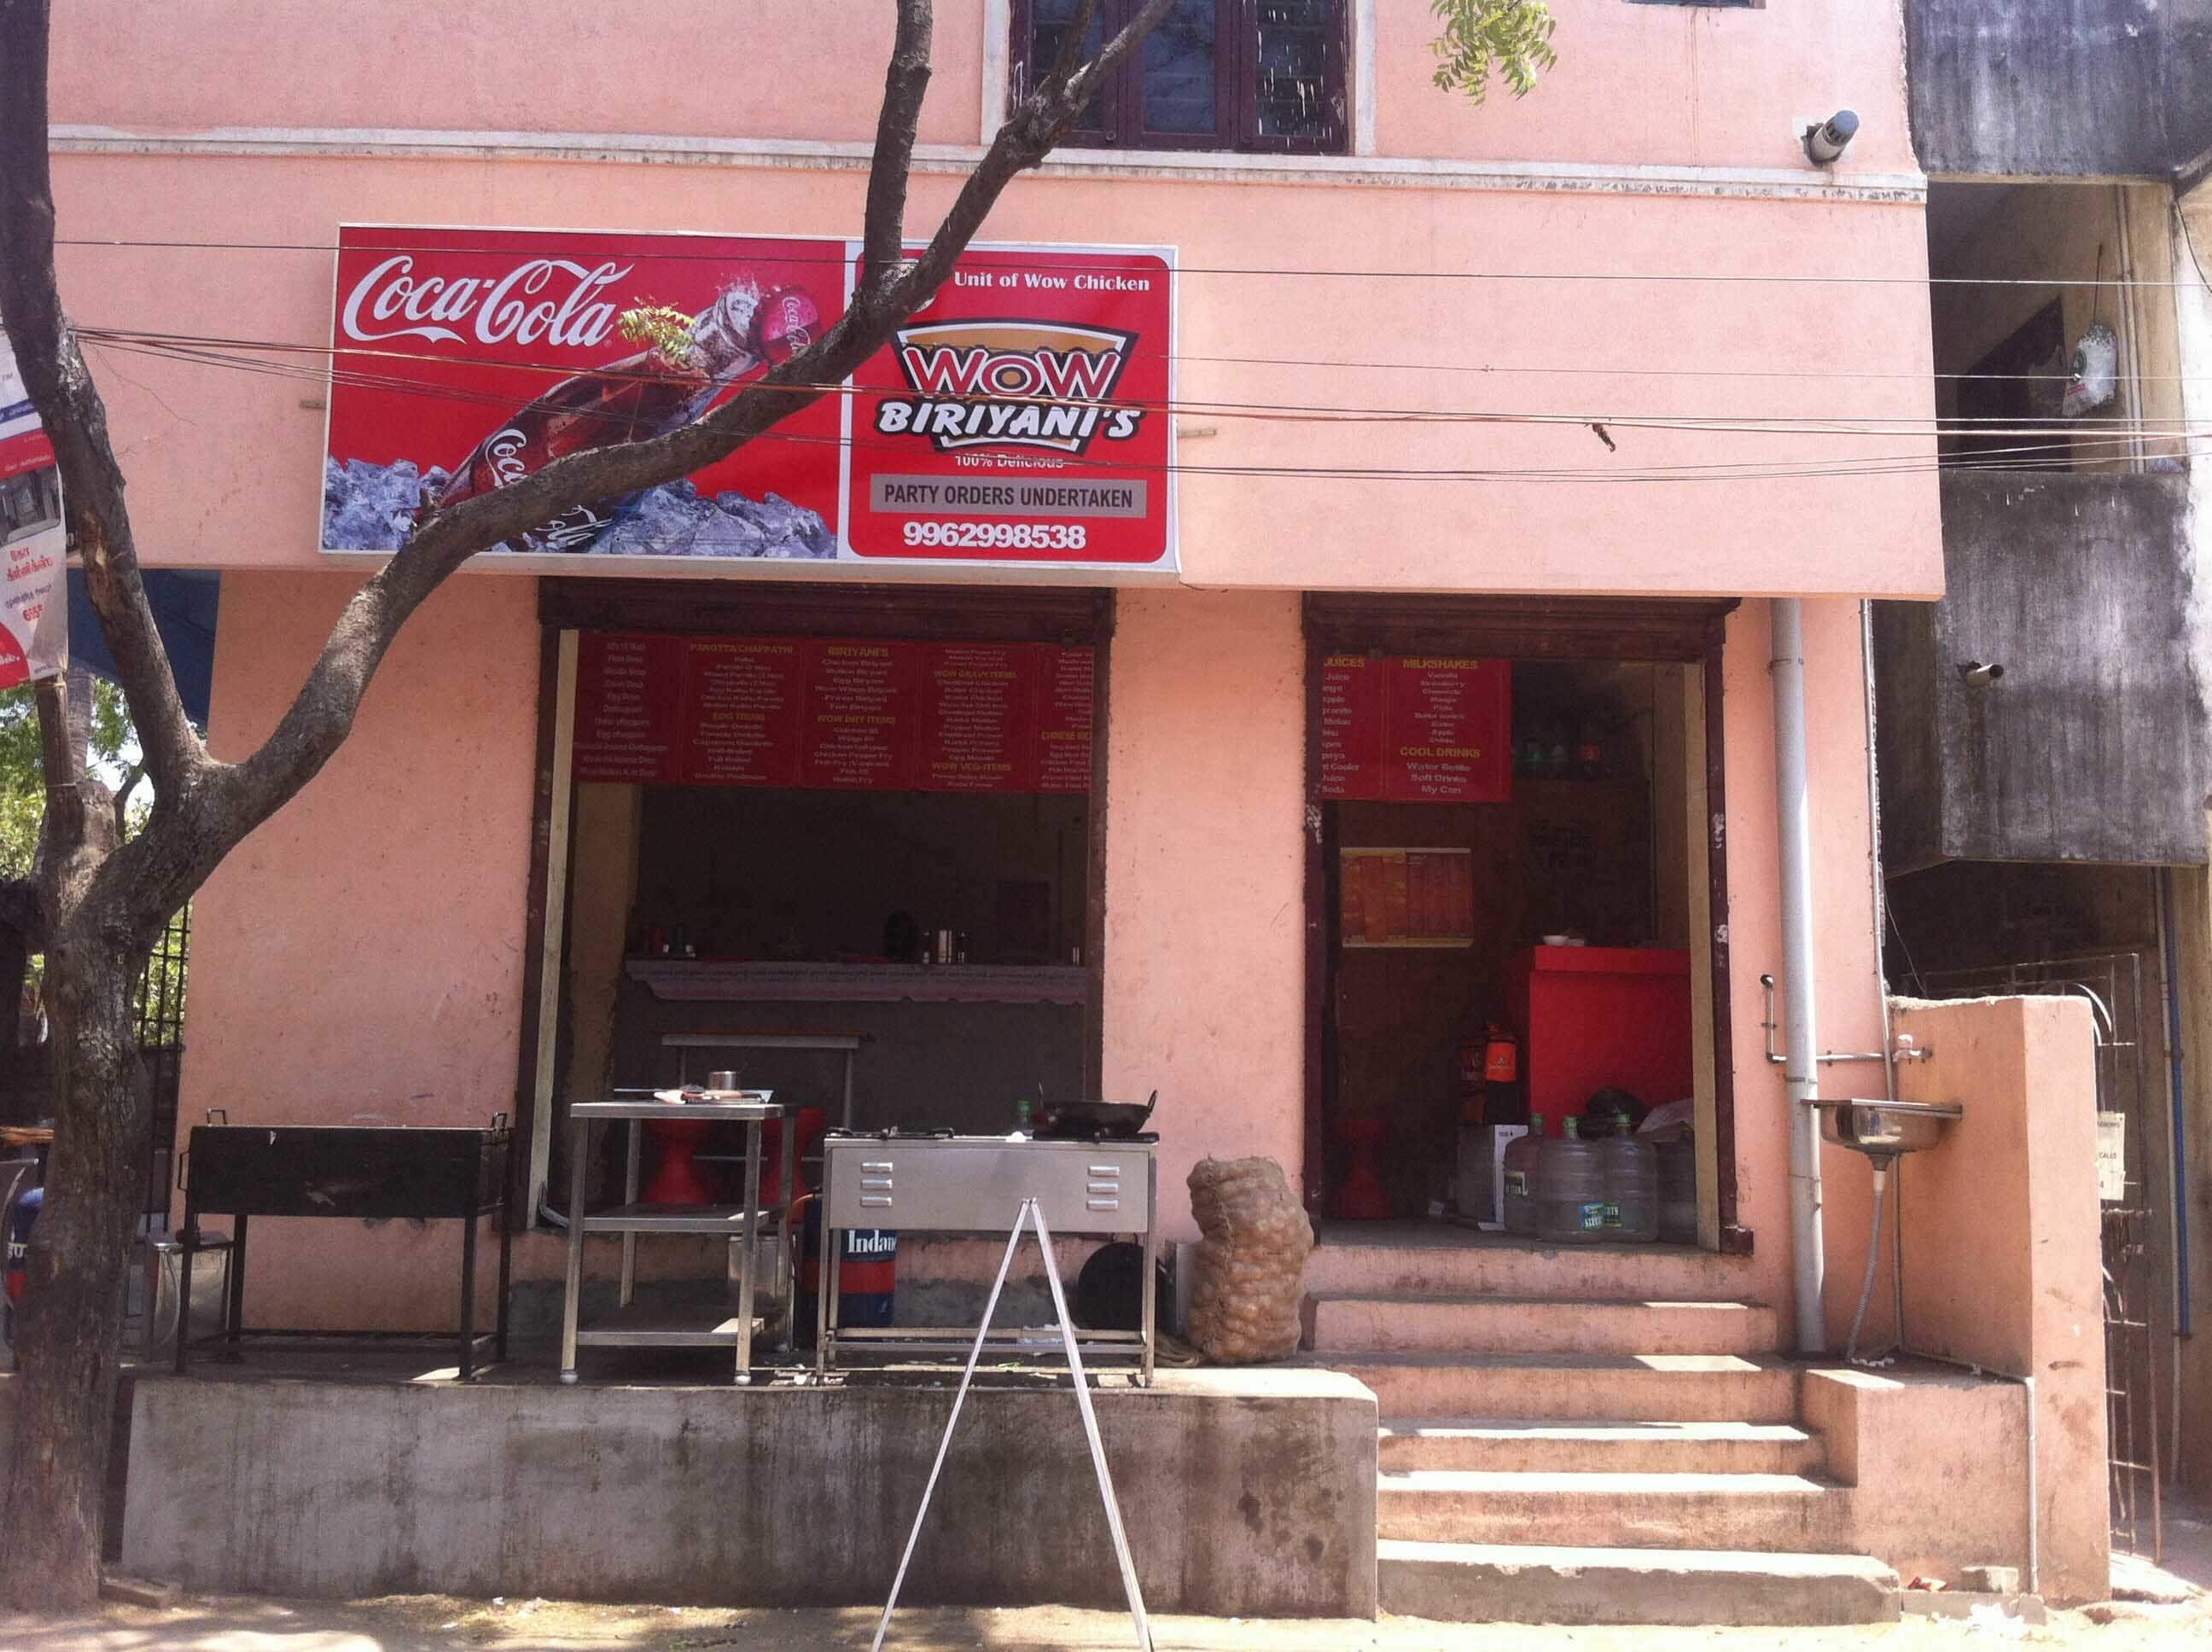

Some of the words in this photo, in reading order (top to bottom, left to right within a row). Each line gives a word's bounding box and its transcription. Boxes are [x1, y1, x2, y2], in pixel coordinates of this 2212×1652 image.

[954, 270, 993, 288] Unit
[999, 271, 1019, 288] of
[1024, 273, 1068, 289] Wow
[1074, 274, 1150, 292] Chicken
[342, 255, 634, 346] Coca-Cola
[901, 348, 1121, 403] WOW
[879, 400, 1141, 438] BIRIYANI'S
[955, 453, 993, 468] 100%
[997, 452, 1065, 469] Delicious
[884, 484, 939, 503] PARTY
[944, 486, 1015, 506] ORDERS
[1021, 487, 1133, 509] UNDERTAKEN
[903, 521, 1086, 550] 9962998538
[1324, 657, 1365, 668] JUICES
[1402, 659, 1477, 670] MILKSHAKES
[1400, 746, 1435, 757] COOL
[1436, 747, 1482, 759] DRINKS
[1411, 773, 1432, 783] Soft
[1434, 775, 1468, 785] Drinks
[1440, 786, 1463, 795] Can
